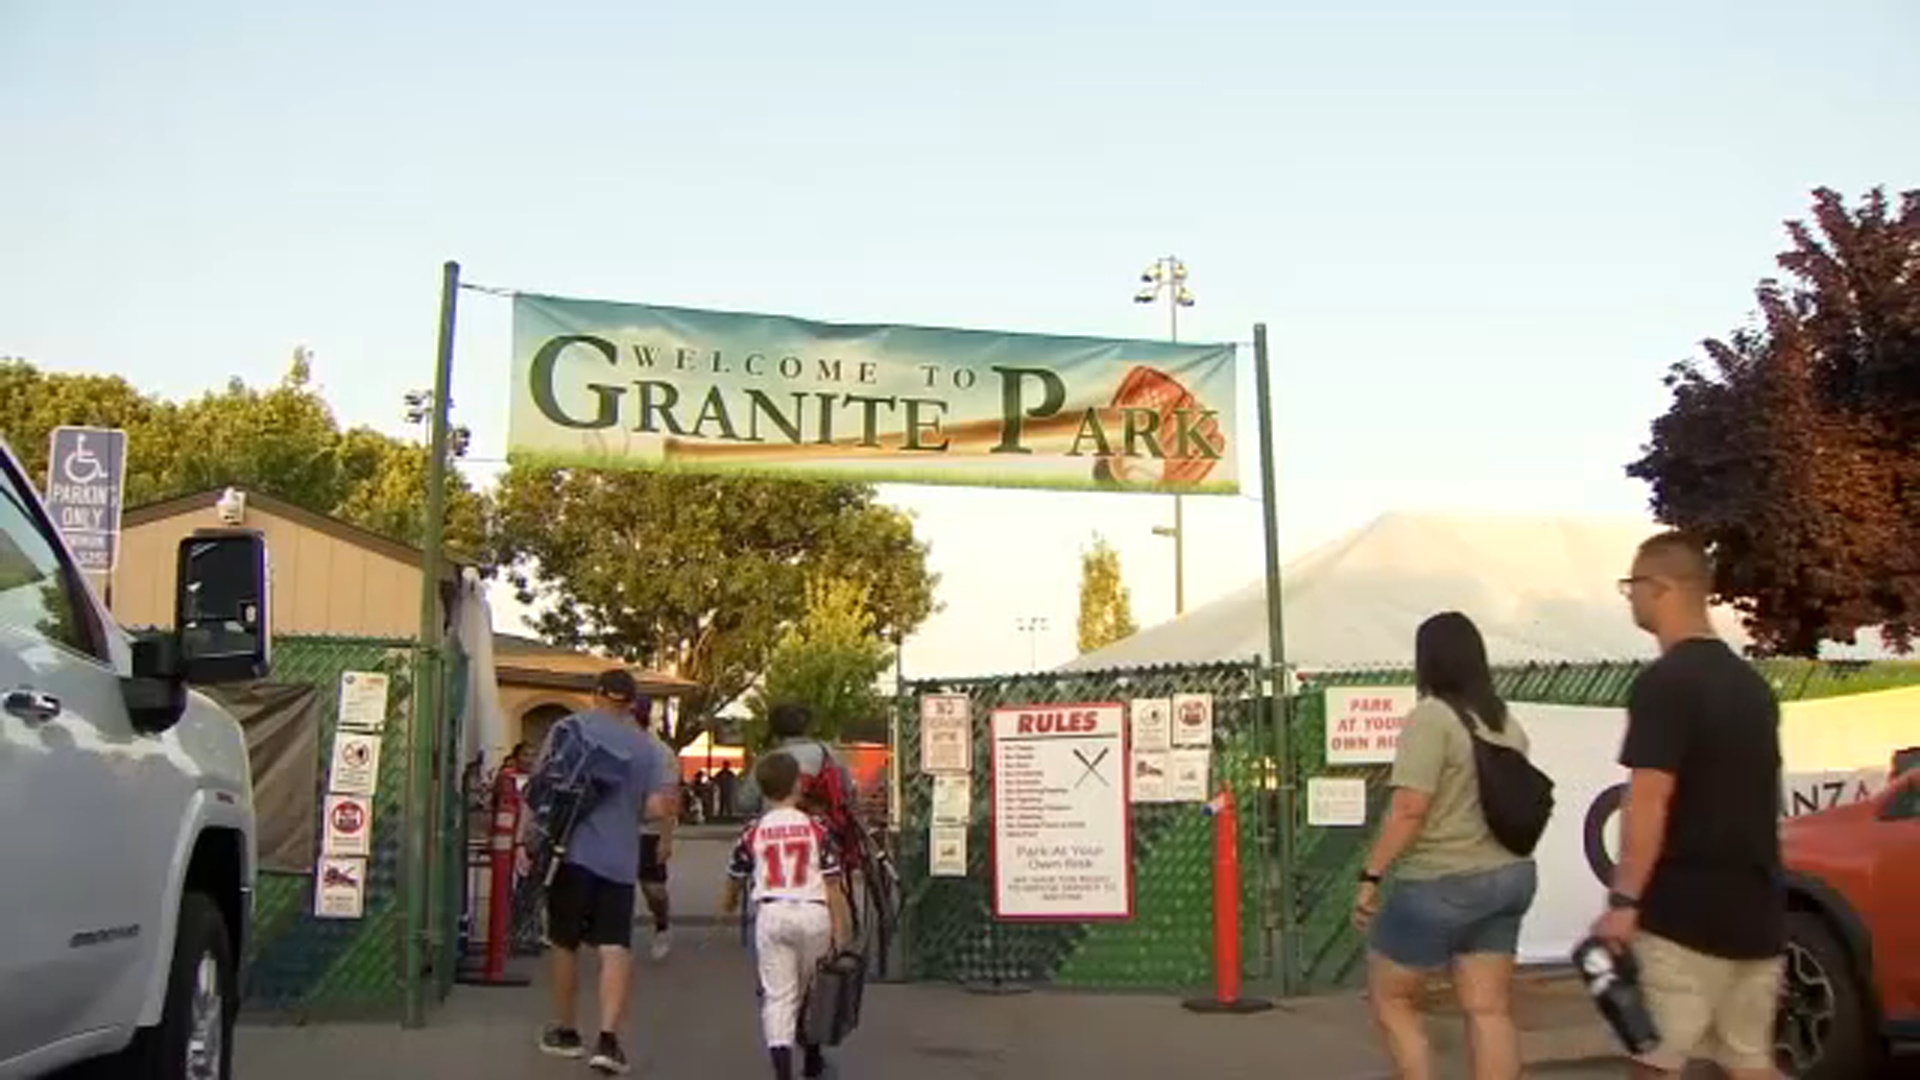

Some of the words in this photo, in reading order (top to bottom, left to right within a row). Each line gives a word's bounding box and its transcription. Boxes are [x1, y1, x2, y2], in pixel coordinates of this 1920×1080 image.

[633, 344, 877, 385] WELCOME
[921, 365, 976, 390] TO
[528, 335, 950, 452] GRANITE
[990, 365, 1223, 461] PARK
[62, 506, 104, 528] ONLY
[1350, 698, 1393, 712] PARK
[1017, 711, 1098, 734] RULES
[1337, 718, 1355, 732] AT
[1331, 736, 1369, 751] OWN
[764, 841, 810, 889] 17
